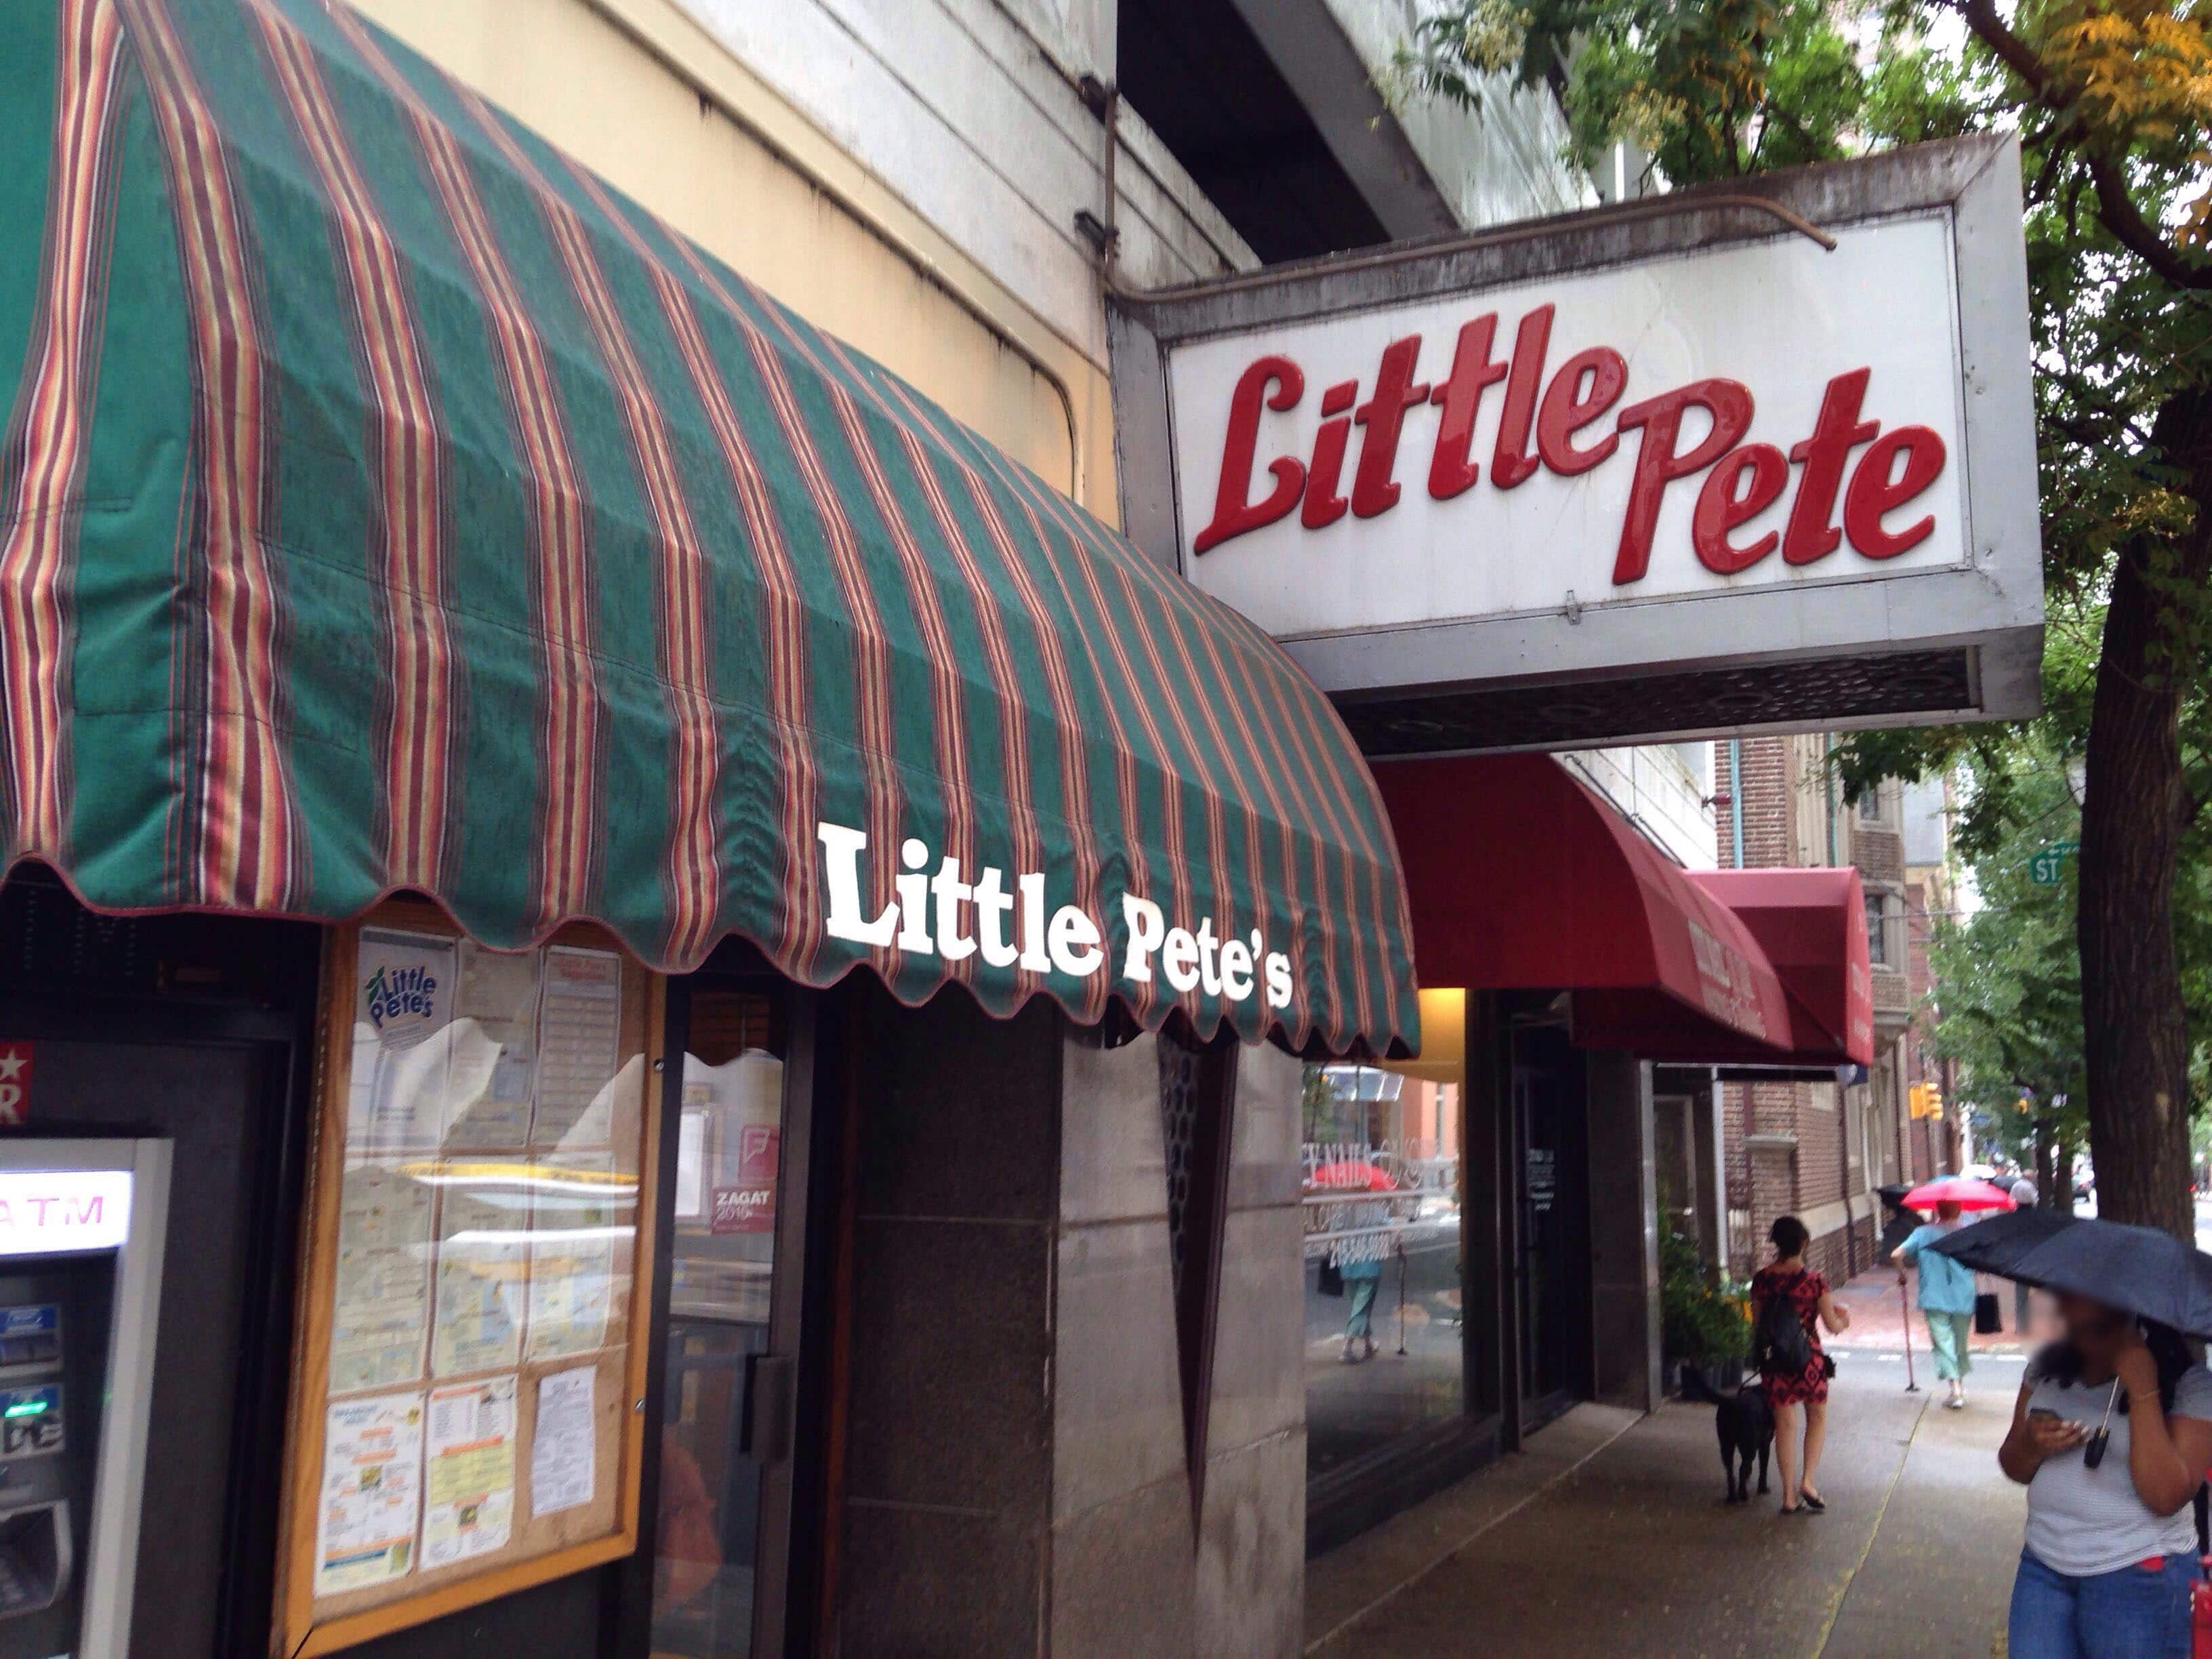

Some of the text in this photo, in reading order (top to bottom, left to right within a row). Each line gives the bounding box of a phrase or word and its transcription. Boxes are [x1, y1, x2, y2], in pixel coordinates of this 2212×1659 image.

[1195, 302, 1946, 586] Little Pete
[2036, 858, 2058, 881] ST
[817, 821, 1292, 1009] Little Pete's
[376, 966, 437, 1002] Little
[716, 1190, 771, 1206] ZAGAT
